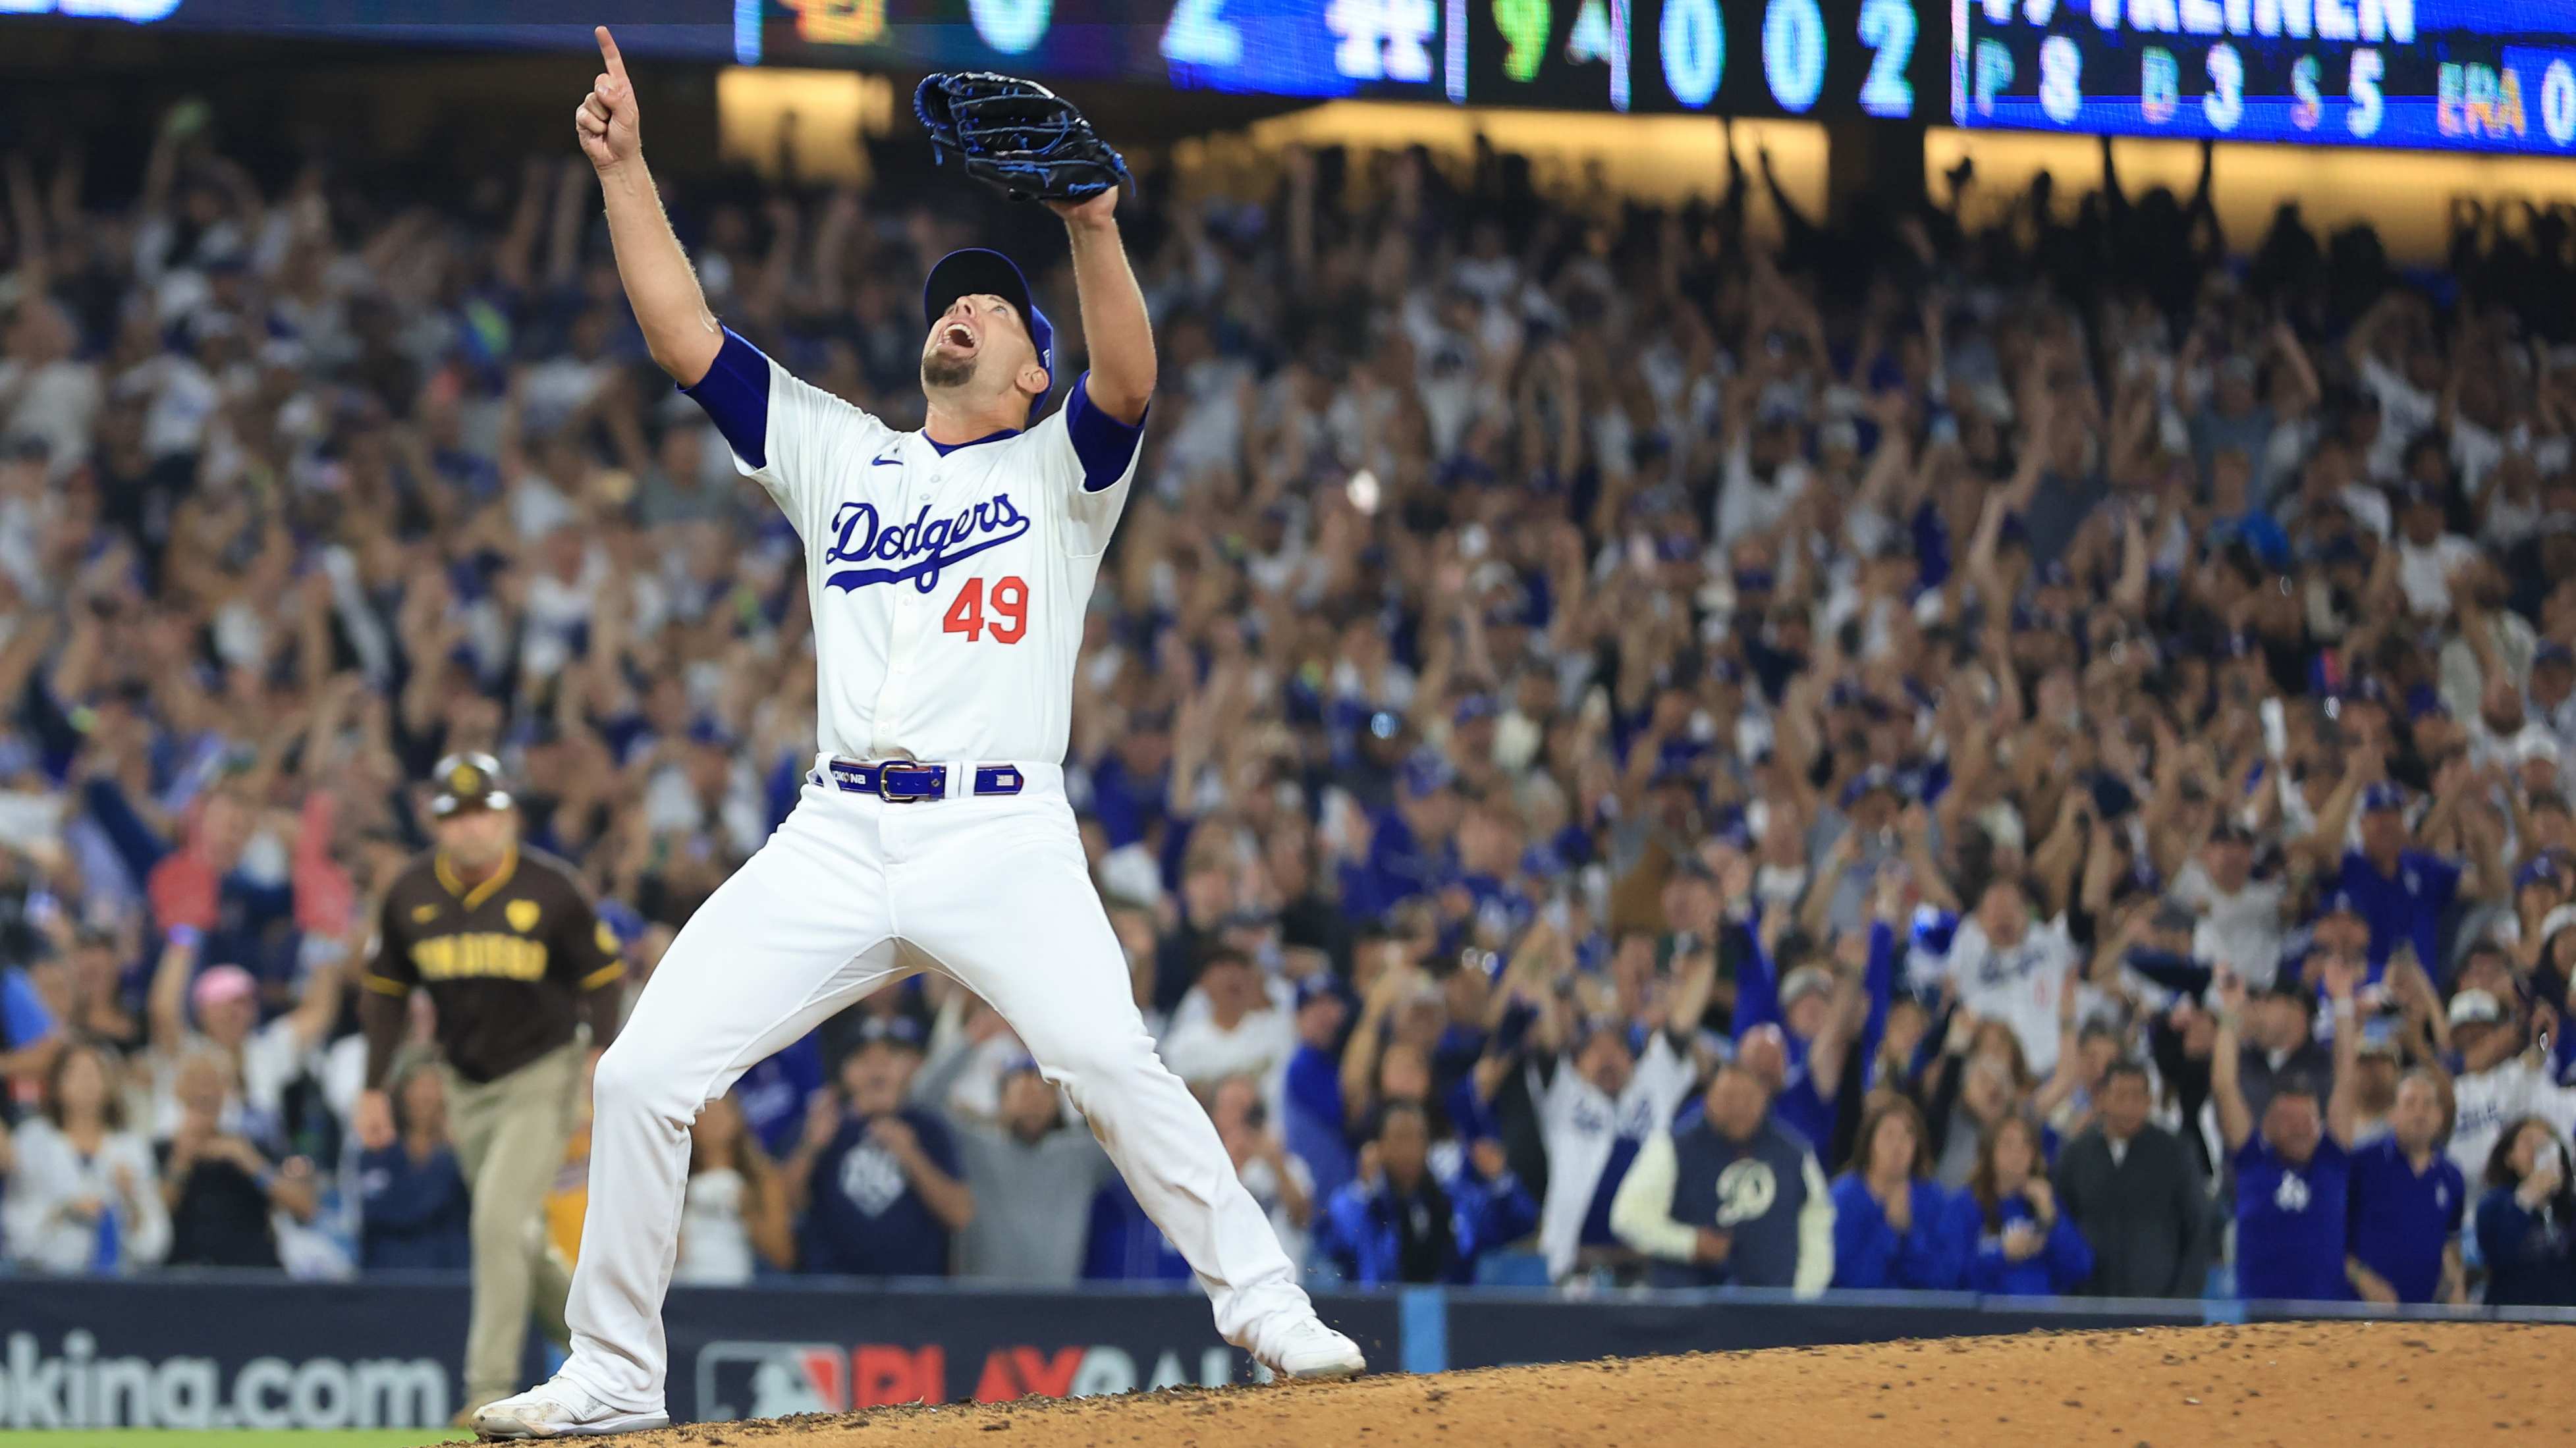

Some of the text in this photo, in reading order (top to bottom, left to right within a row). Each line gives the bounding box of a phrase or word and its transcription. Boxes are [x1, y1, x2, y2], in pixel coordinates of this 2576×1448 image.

[1659, 0, 1918, 119] 0 0 2
[1976, 37, 2014, 117] P
[2039, 35, 2082, 124] 8
[2203, 41, 2244, 132] 3
[2290, 54, 2323, 130] S
[2347, 48, 2385, 138] 5
[2438, 62, 2526, 136] ERA
[825, 493, 1030, 593] Dodgers
[943, 576, 1029, 645] 49
[832, 770, 866, 784] OKONA
[0, 1329, 453, 1429] king.com
